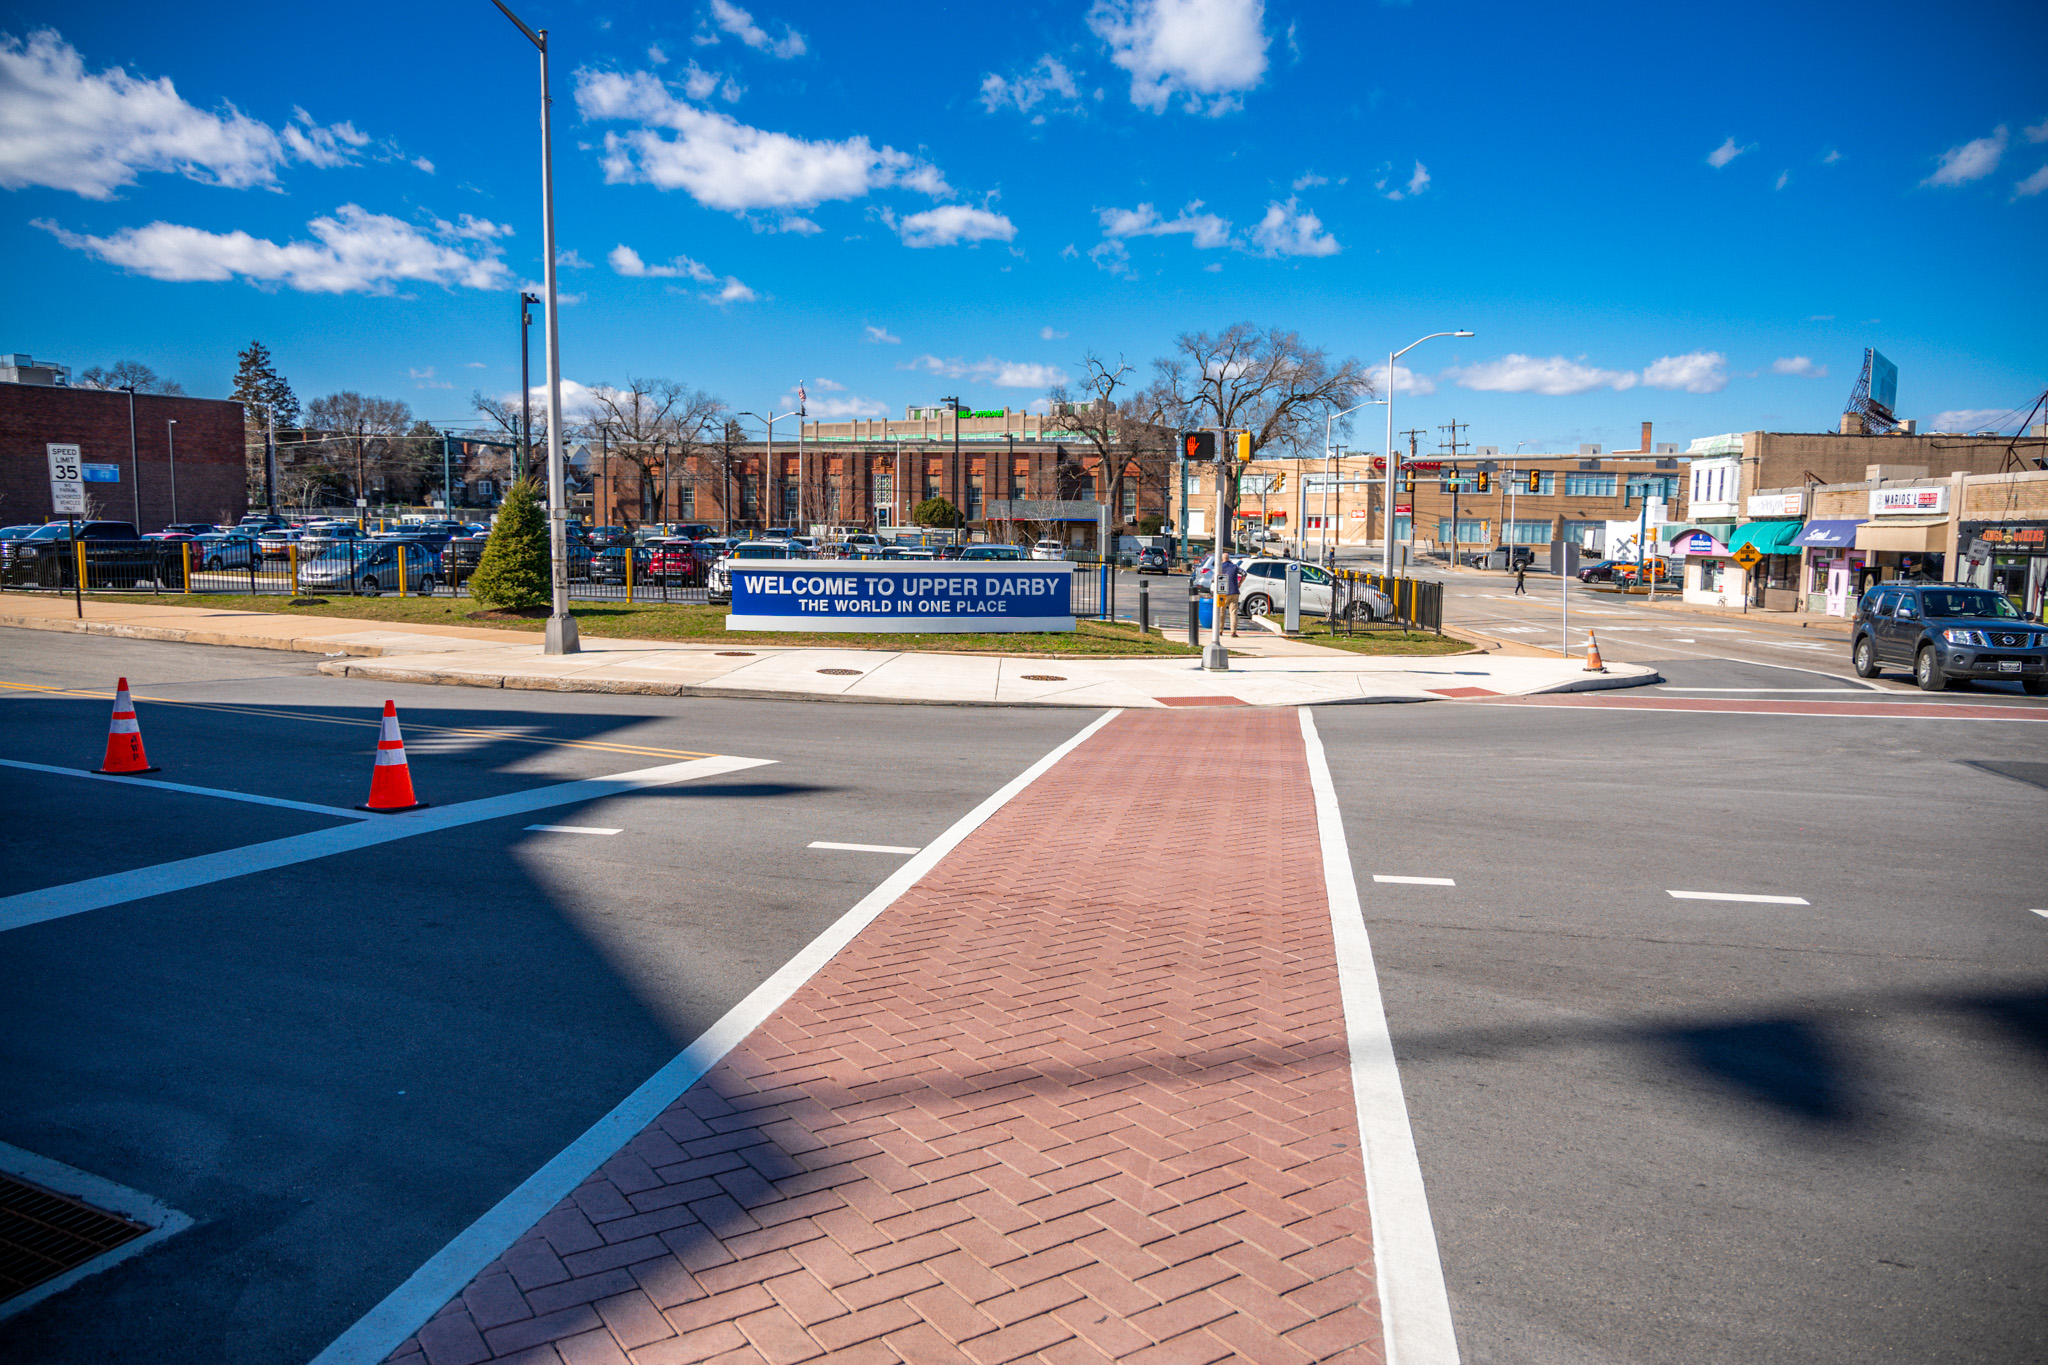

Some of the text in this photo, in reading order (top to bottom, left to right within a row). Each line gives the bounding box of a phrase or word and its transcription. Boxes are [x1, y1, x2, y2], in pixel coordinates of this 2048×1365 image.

[958, 409, 1004, 418] SELF STORAGE
[55, 465, 78, 480] 35
[1982, 529, 2045, 542] KINGS QUEENS
[744, 575, 1060, 596] WELCOME TO UPPER DARBY
[798, 599, 1007, 613] THE WORLD IN ONE PLACE
[130, 734, 139, 762] AWP
